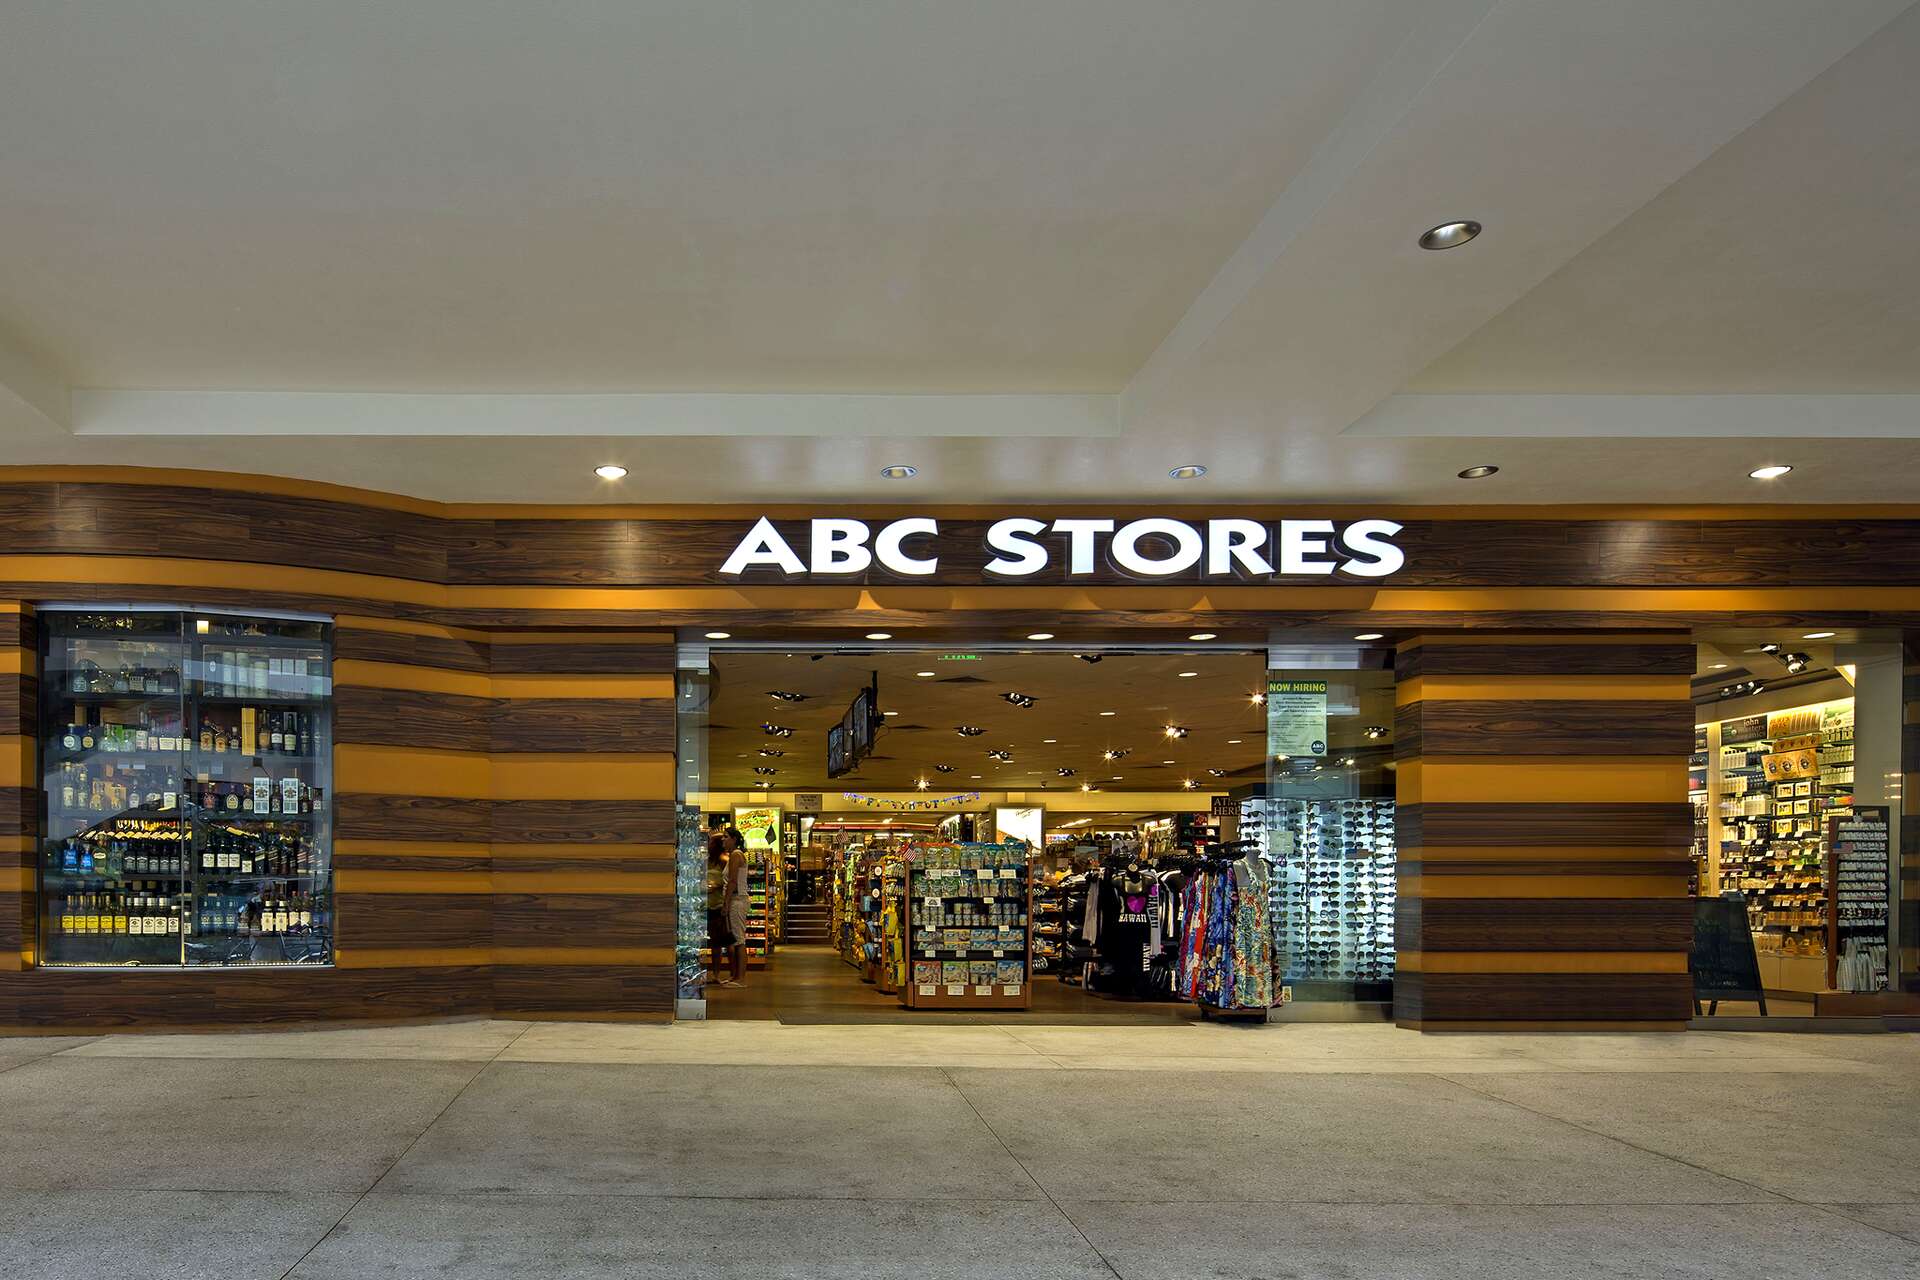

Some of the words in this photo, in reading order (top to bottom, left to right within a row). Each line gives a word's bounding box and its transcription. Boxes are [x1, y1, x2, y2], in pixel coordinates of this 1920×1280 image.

[719, 516, 938, 575] ABC
[984, 518, 1404, 577] STORES
[1269, 683, 1290, 691] NOW
[1293, 683, 1326, 691] HIRING
